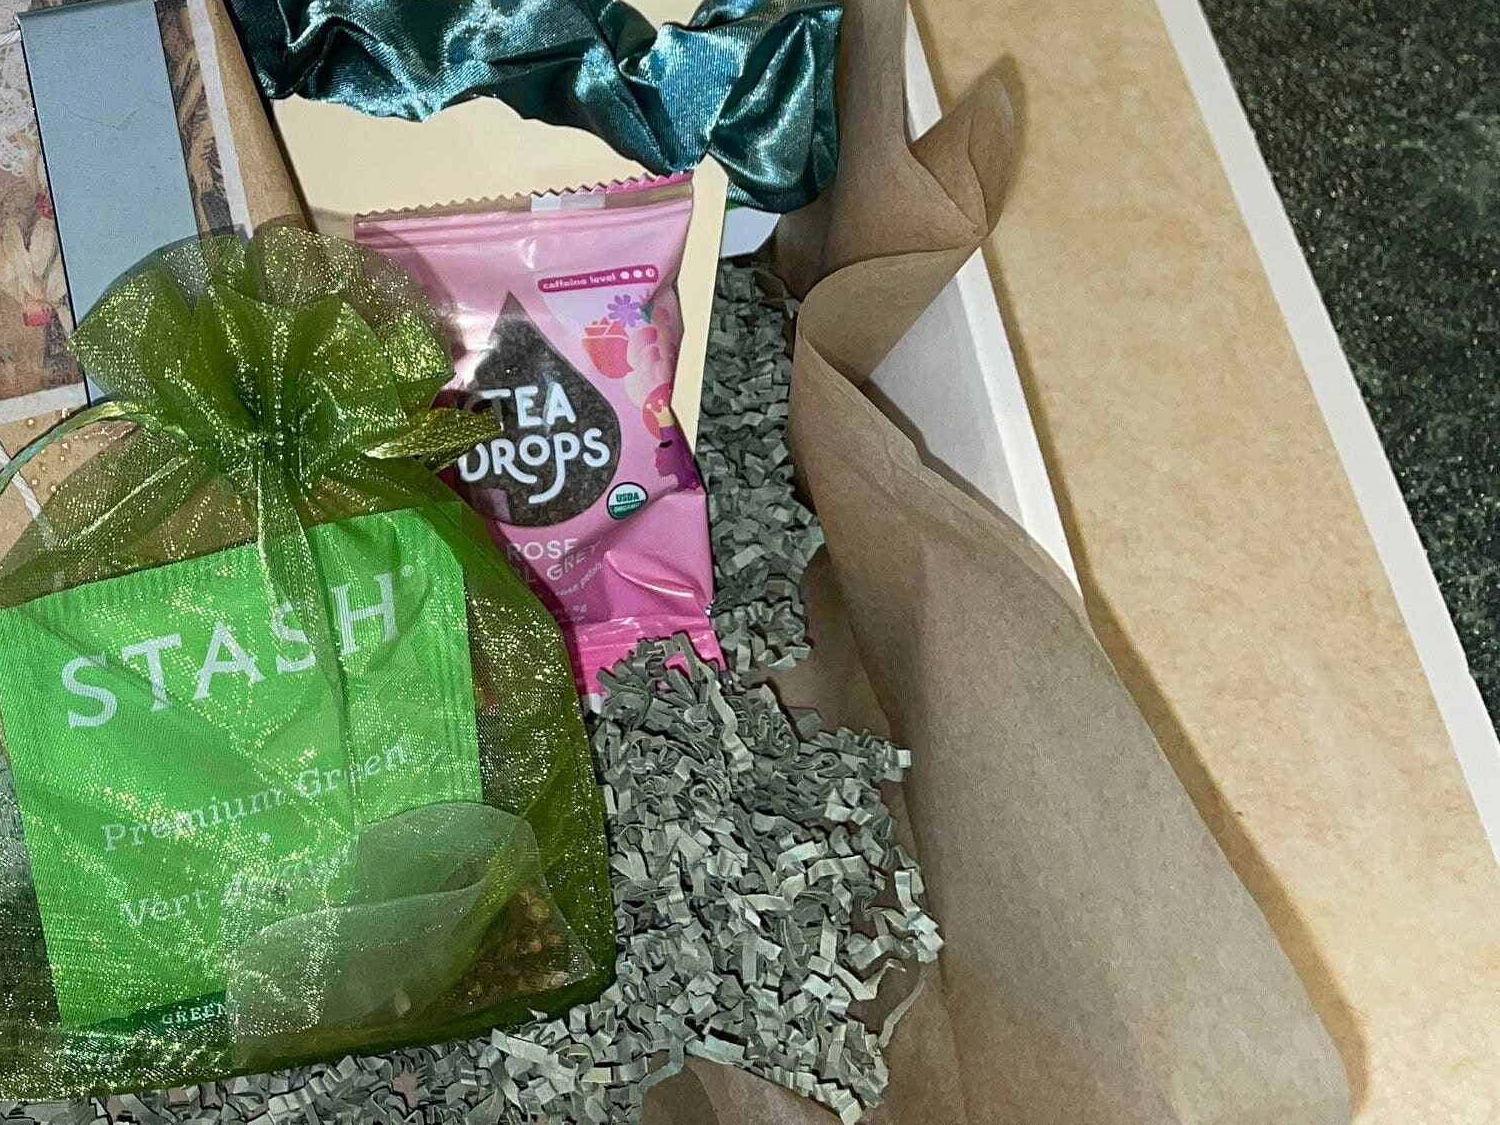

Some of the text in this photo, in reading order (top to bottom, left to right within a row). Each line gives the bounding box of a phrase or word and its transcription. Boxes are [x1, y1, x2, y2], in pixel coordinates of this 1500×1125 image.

[543, 272, 616, 290] caffeine level
[463, 381, 577, 431] TEA
[457, 427, 611, 504] DROPS
[615, 492, 639, 503] USDA
[59, 572, 399, 729] STASH
[101, 742, 407, 854] Premium Green
[118, 887, 210, 926] Vert
